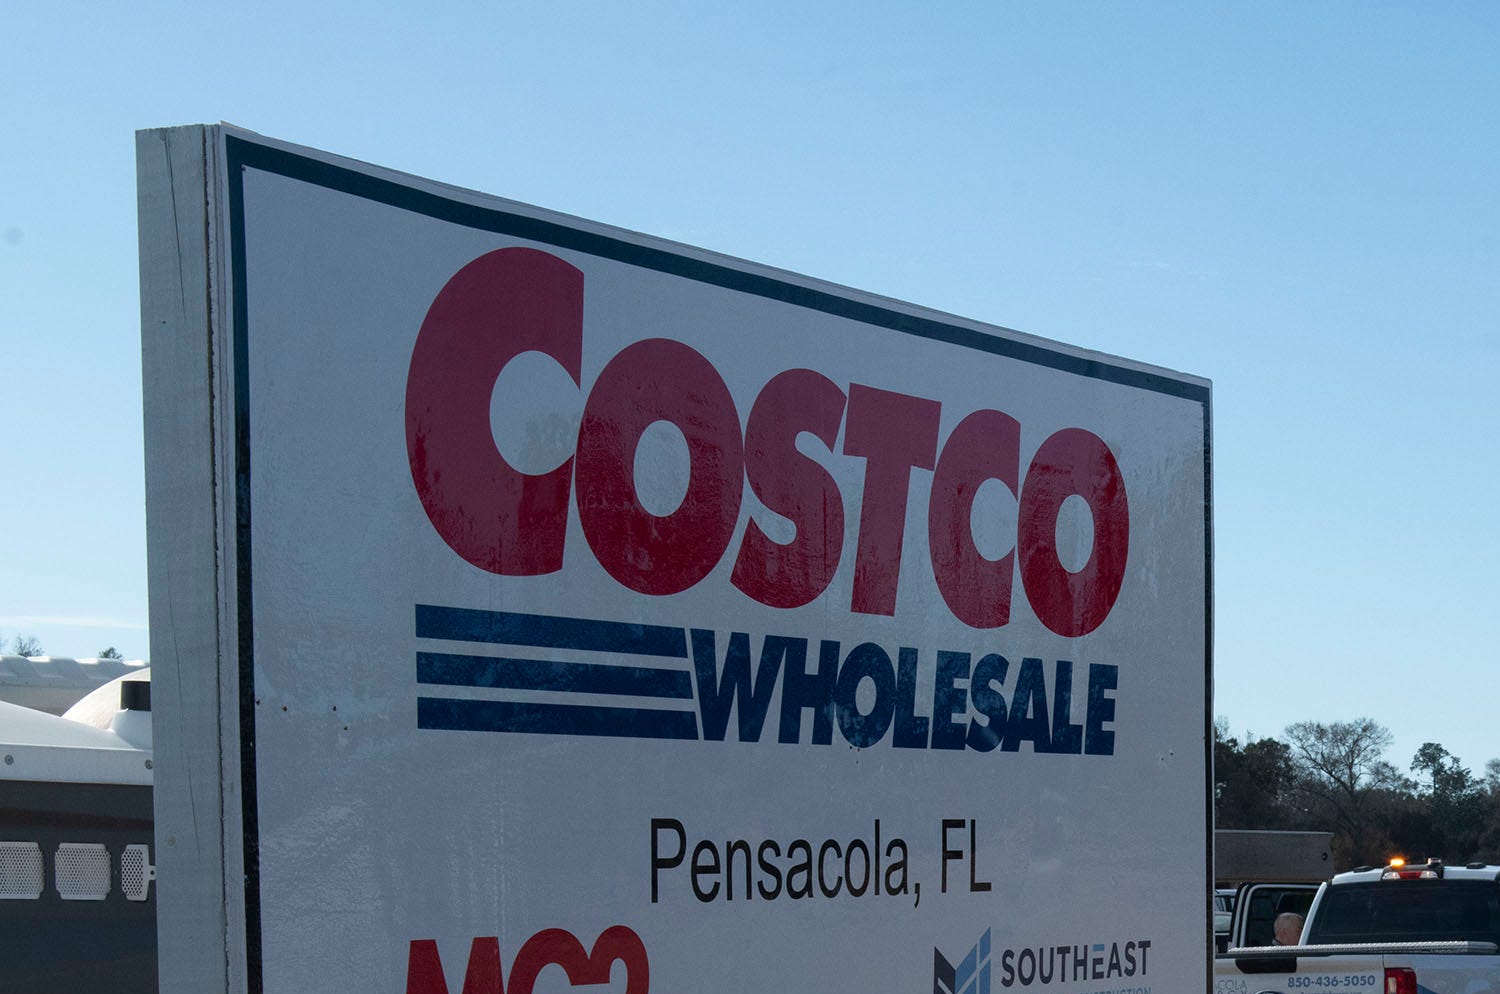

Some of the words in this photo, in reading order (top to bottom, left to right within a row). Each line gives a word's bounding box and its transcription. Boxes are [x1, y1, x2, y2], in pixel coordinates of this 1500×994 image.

[404, 246, 1130, 637] COSTCO
[688, 628, 1119, 756] WHOLESALE
[650, 818, 921, 908] Pensacola,
[941, 817, 992, 893] FL
[1001, 940, 1151, 987] SOUTHEAST
[1287, 974, 1376, 989] 850-436-5050
